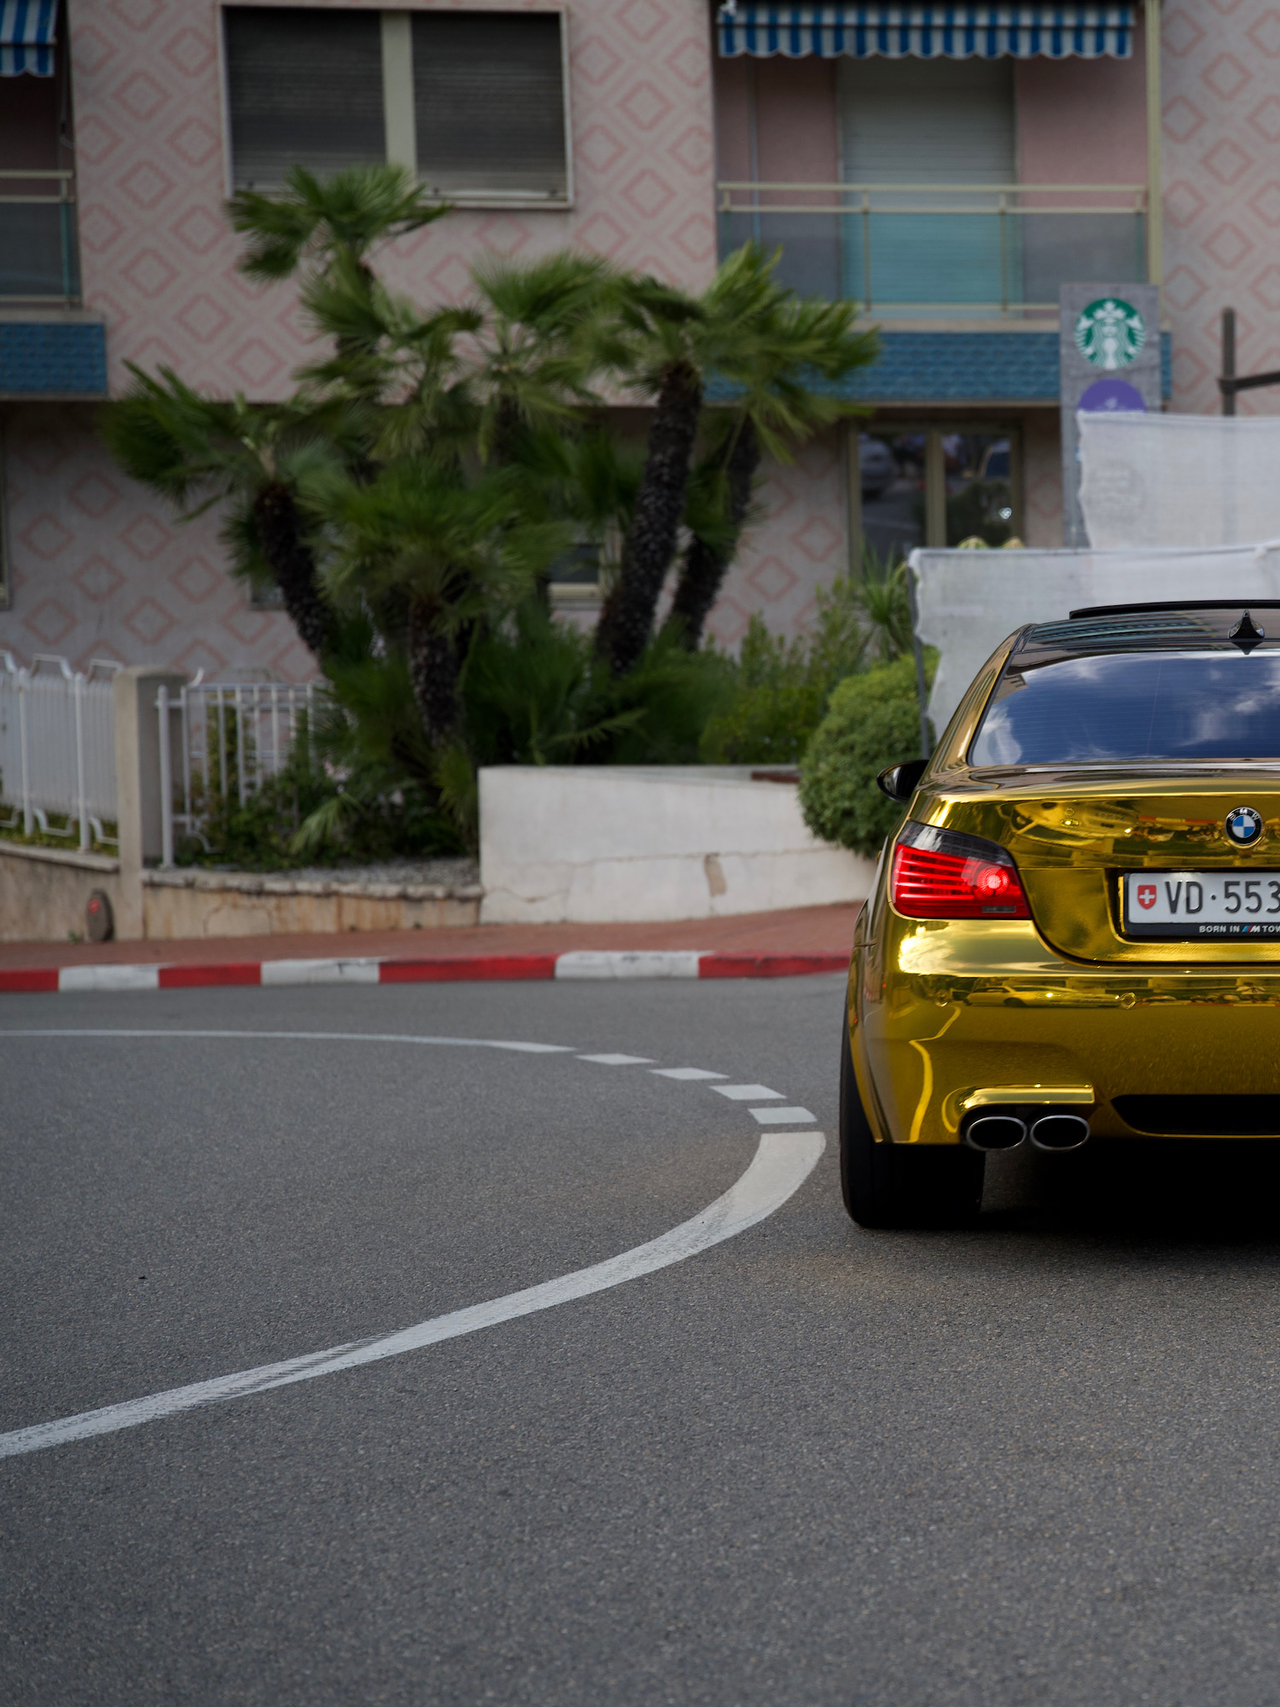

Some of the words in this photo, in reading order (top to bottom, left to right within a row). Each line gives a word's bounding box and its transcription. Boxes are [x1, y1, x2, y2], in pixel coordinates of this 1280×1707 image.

[1230, 807, 1260, 821] BMW
[1199, 925, 1227, 933] BORN
[1229, 925, 1240, 933] IN
